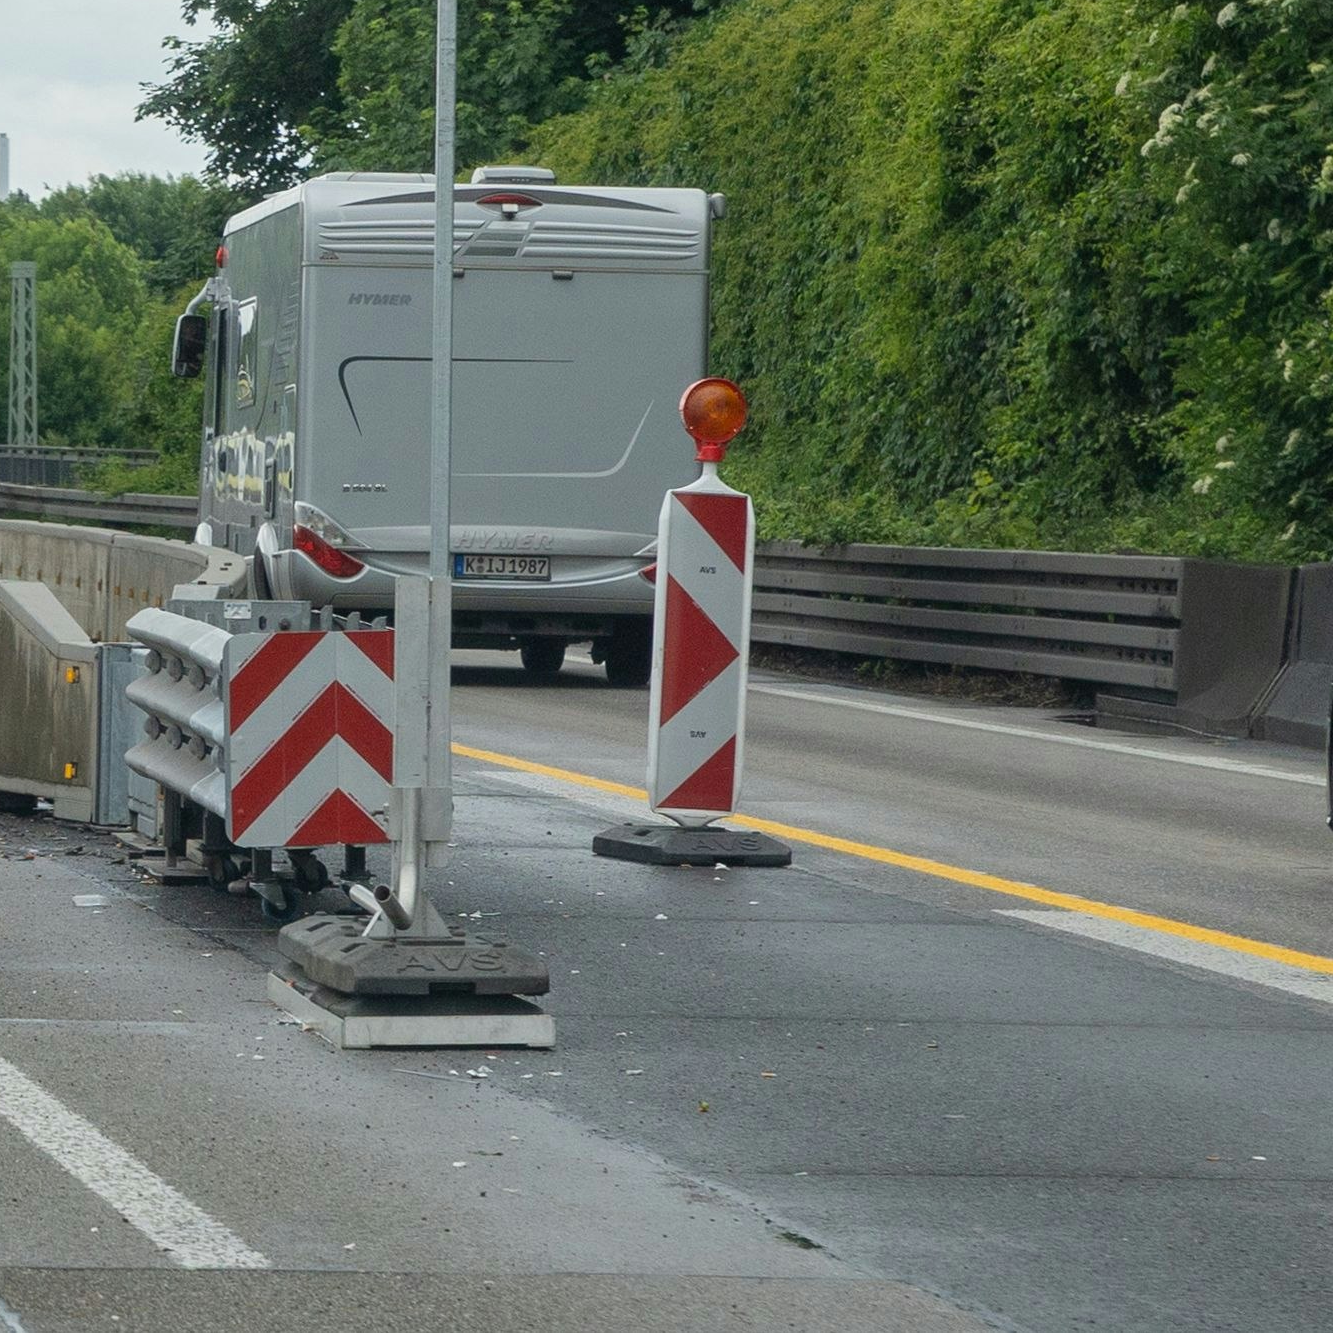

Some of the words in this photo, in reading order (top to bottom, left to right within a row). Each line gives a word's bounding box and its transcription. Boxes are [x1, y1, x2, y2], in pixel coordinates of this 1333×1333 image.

[348, 293, 412, 306] HYMER
[454, 530, 554, 550] HYMER
[465, 557, 475, 573] K
[508, 558, 547, 575] 1987
[397, 951, 505, 973] AVS
